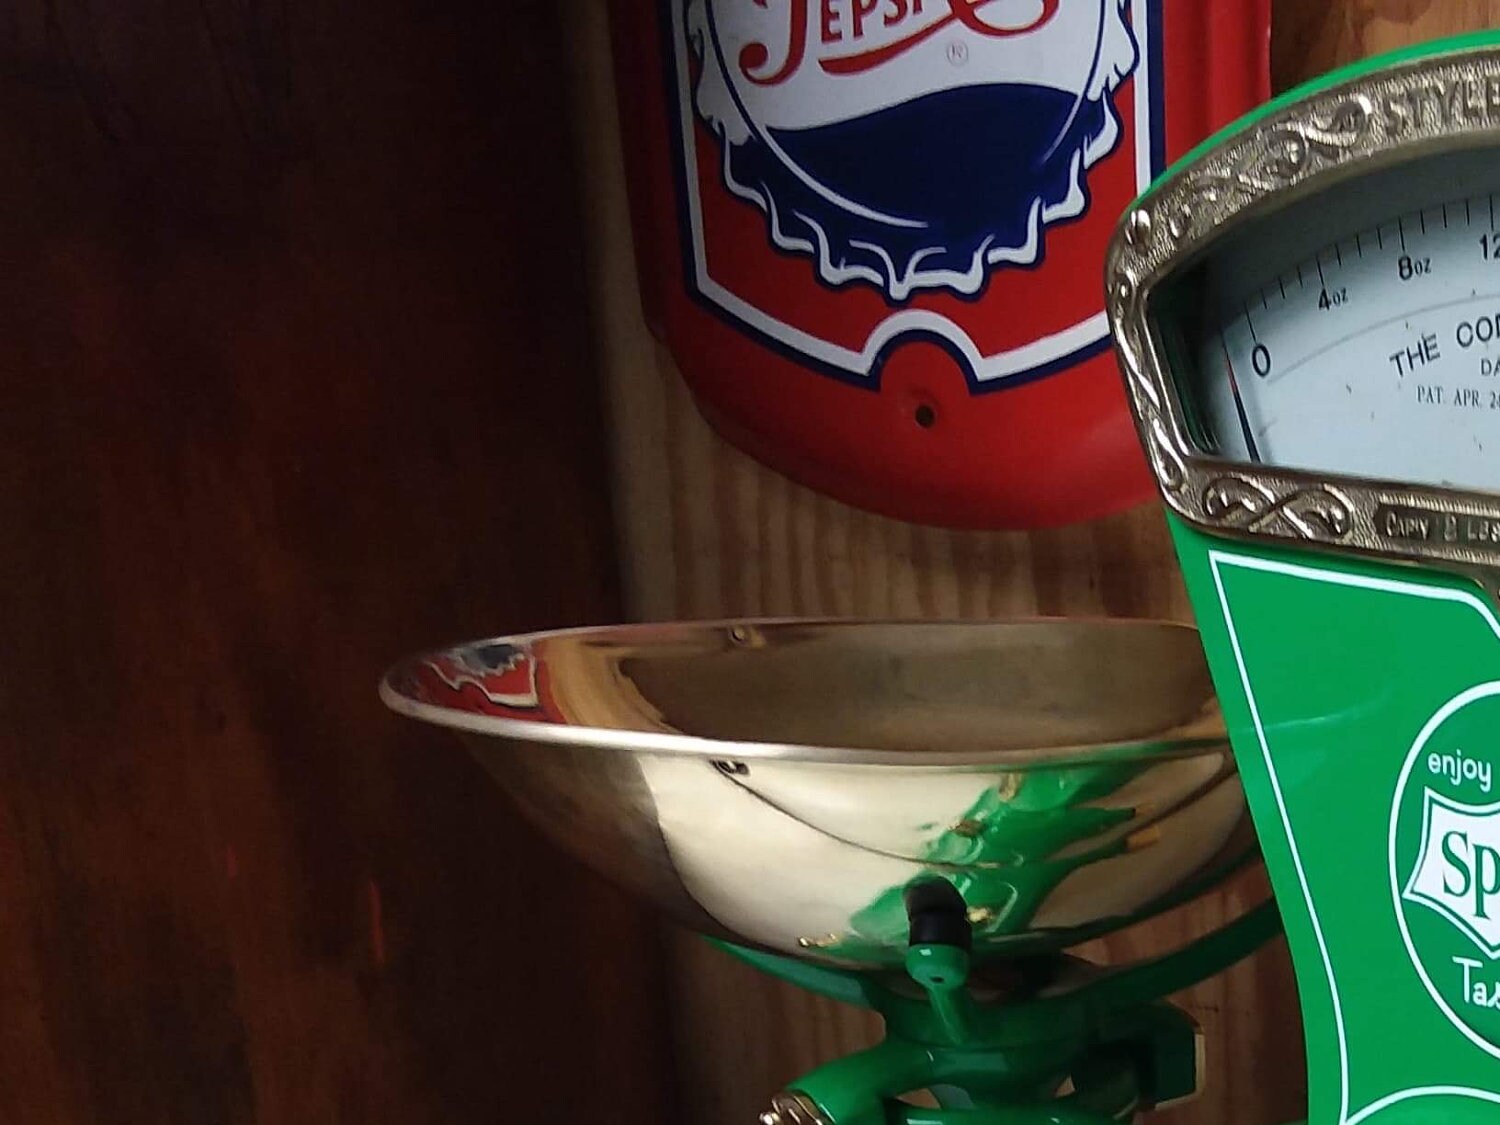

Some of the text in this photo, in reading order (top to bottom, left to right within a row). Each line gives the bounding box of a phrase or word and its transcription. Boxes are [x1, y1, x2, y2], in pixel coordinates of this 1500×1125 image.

[738, 0, 926, 87] PEPS
[1251, 342, 1272, 378] 0
[1389, 333, 1441, 379] THE
[1427, 748, 1493, 793] enjoy
